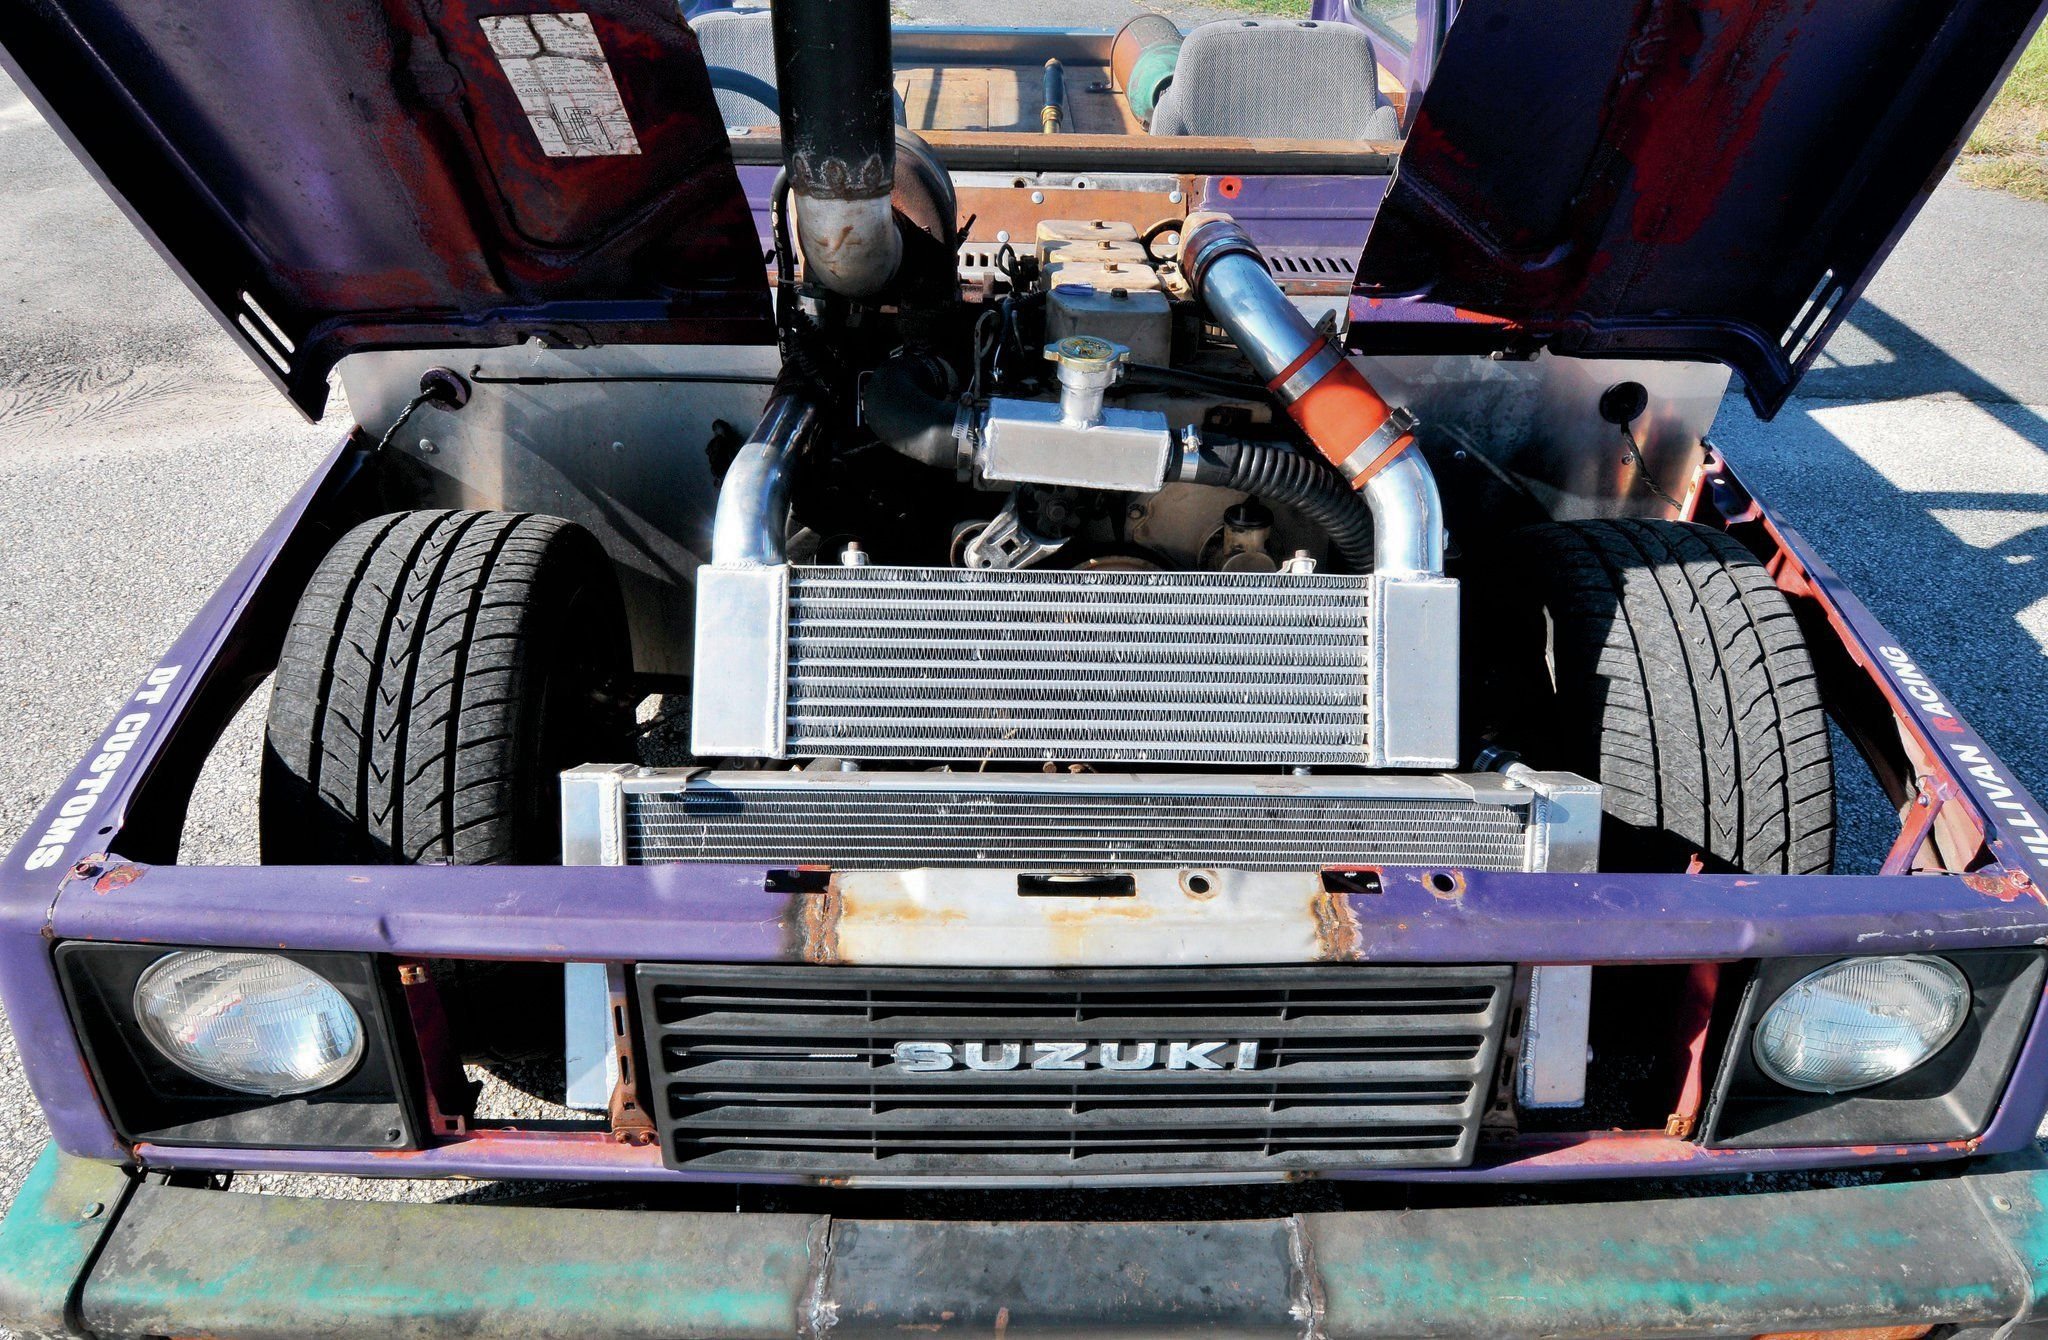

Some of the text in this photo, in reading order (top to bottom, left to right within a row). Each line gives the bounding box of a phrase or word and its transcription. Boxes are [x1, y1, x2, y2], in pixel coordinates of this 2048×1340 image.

[1879, 646, 1965, 734] RACING
[24, 664, 182, 871] DT CUSTOMS
[892, 1040, 1260, 1071] SUZUKI
